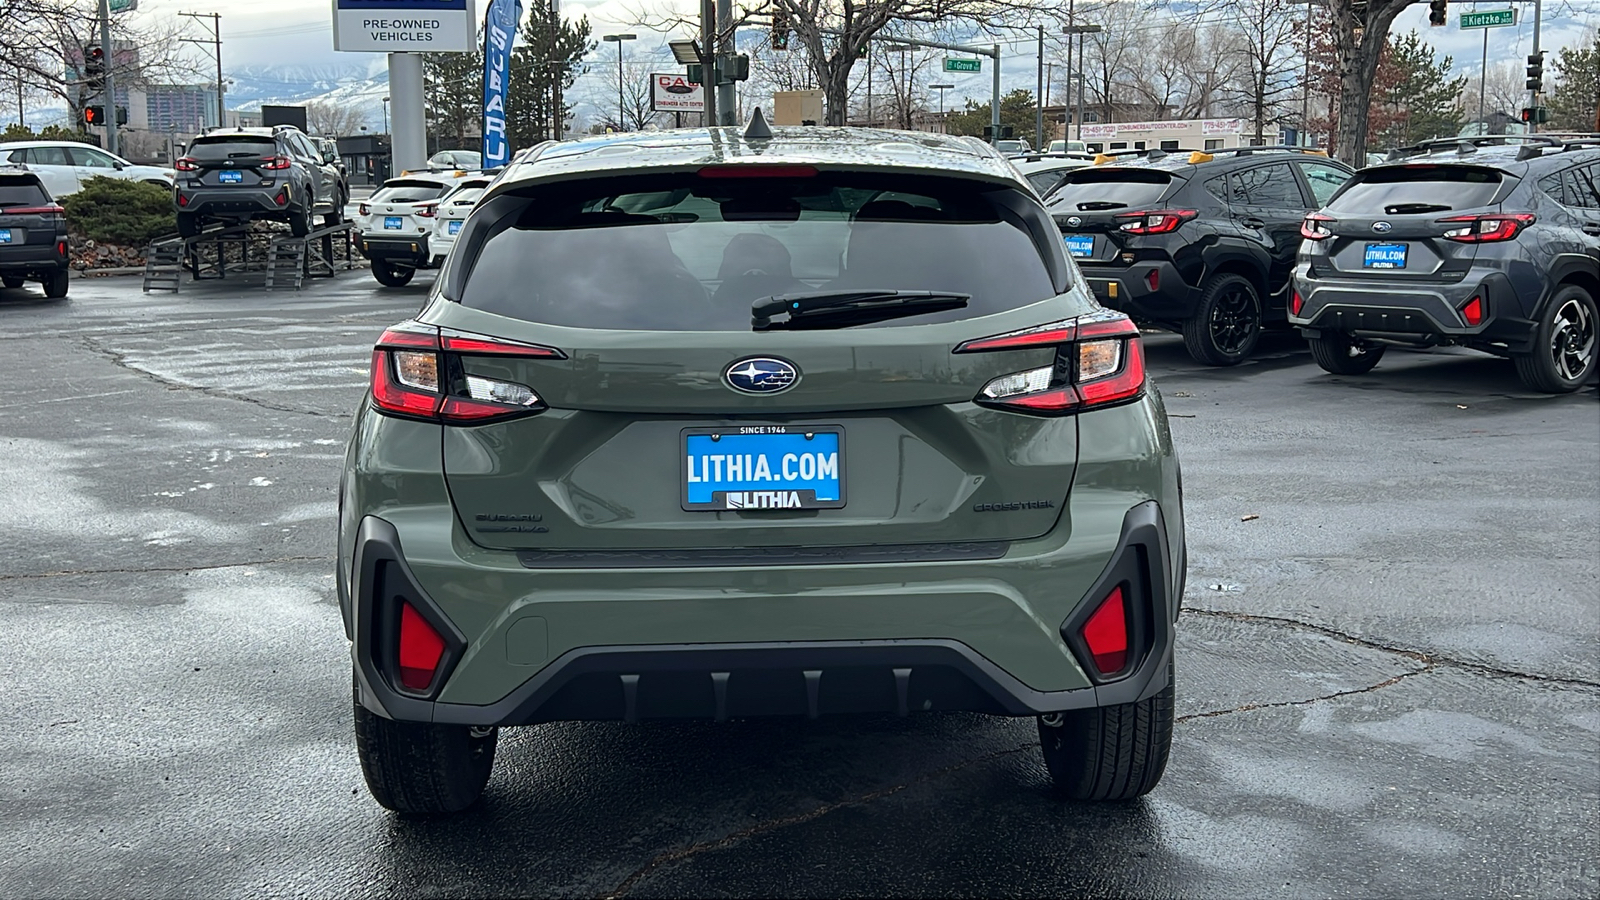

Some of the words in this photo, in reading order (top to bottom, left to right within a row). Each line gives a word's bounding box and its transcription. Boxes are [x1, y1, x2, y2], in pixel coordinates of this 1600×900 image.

[363, 19, 440, 29] PRE-OWNED
[1469, 15, 1500, 25] Kietzke
[371, 32, 433, 41] VEHICLES
[956, 61, 973, 70] Grove
[486, 26, 507, 160] SUBARU
[1066, 241, 1093, 251] THIA.COM
[1365, 250, 1406, 261] LITHIA.COM
[740, 426, 764, 434] SINCE
[767, 426, 786, 434] 1946
[687, 452, 838, 483] LITHIA.COM
[744, 491, 802, 508] LITHIA
[973, 500, 1055, 512] CROSSTREK
[475, 513, 542, 522] SUBARU
